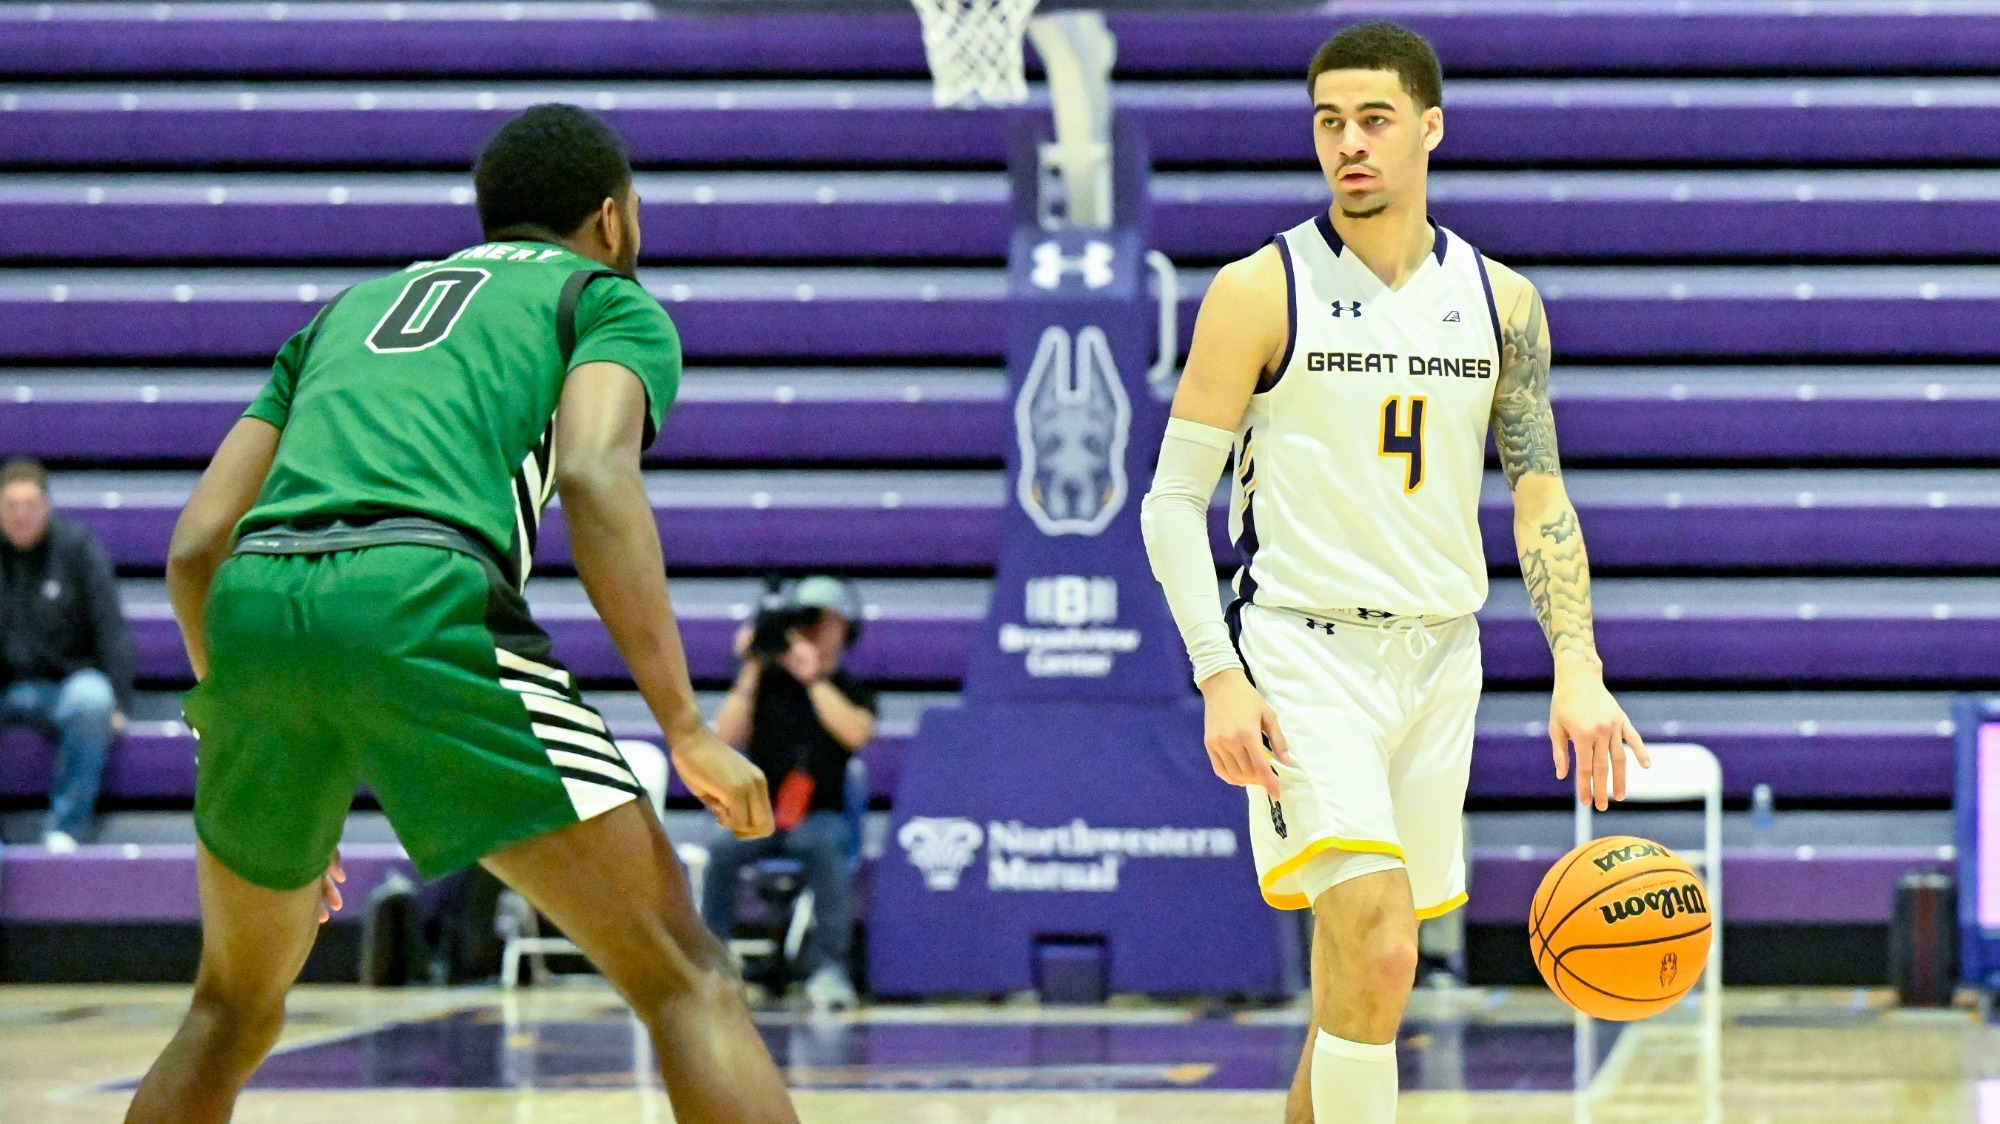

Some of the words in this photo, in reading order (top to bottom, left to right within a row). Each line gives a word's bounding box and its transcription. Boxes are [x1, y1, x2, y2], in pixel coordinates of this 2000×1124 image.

[364, 267, 492, 354] 0
[1307, 351, 1398, 374] GREAT
[1408, 355, 1492, 379] DANES
[1378, 395, 1428, 494] 4
[1592, 843, 1671, 873] NCAA
[1599, 883, 1707, 925] Wilson
